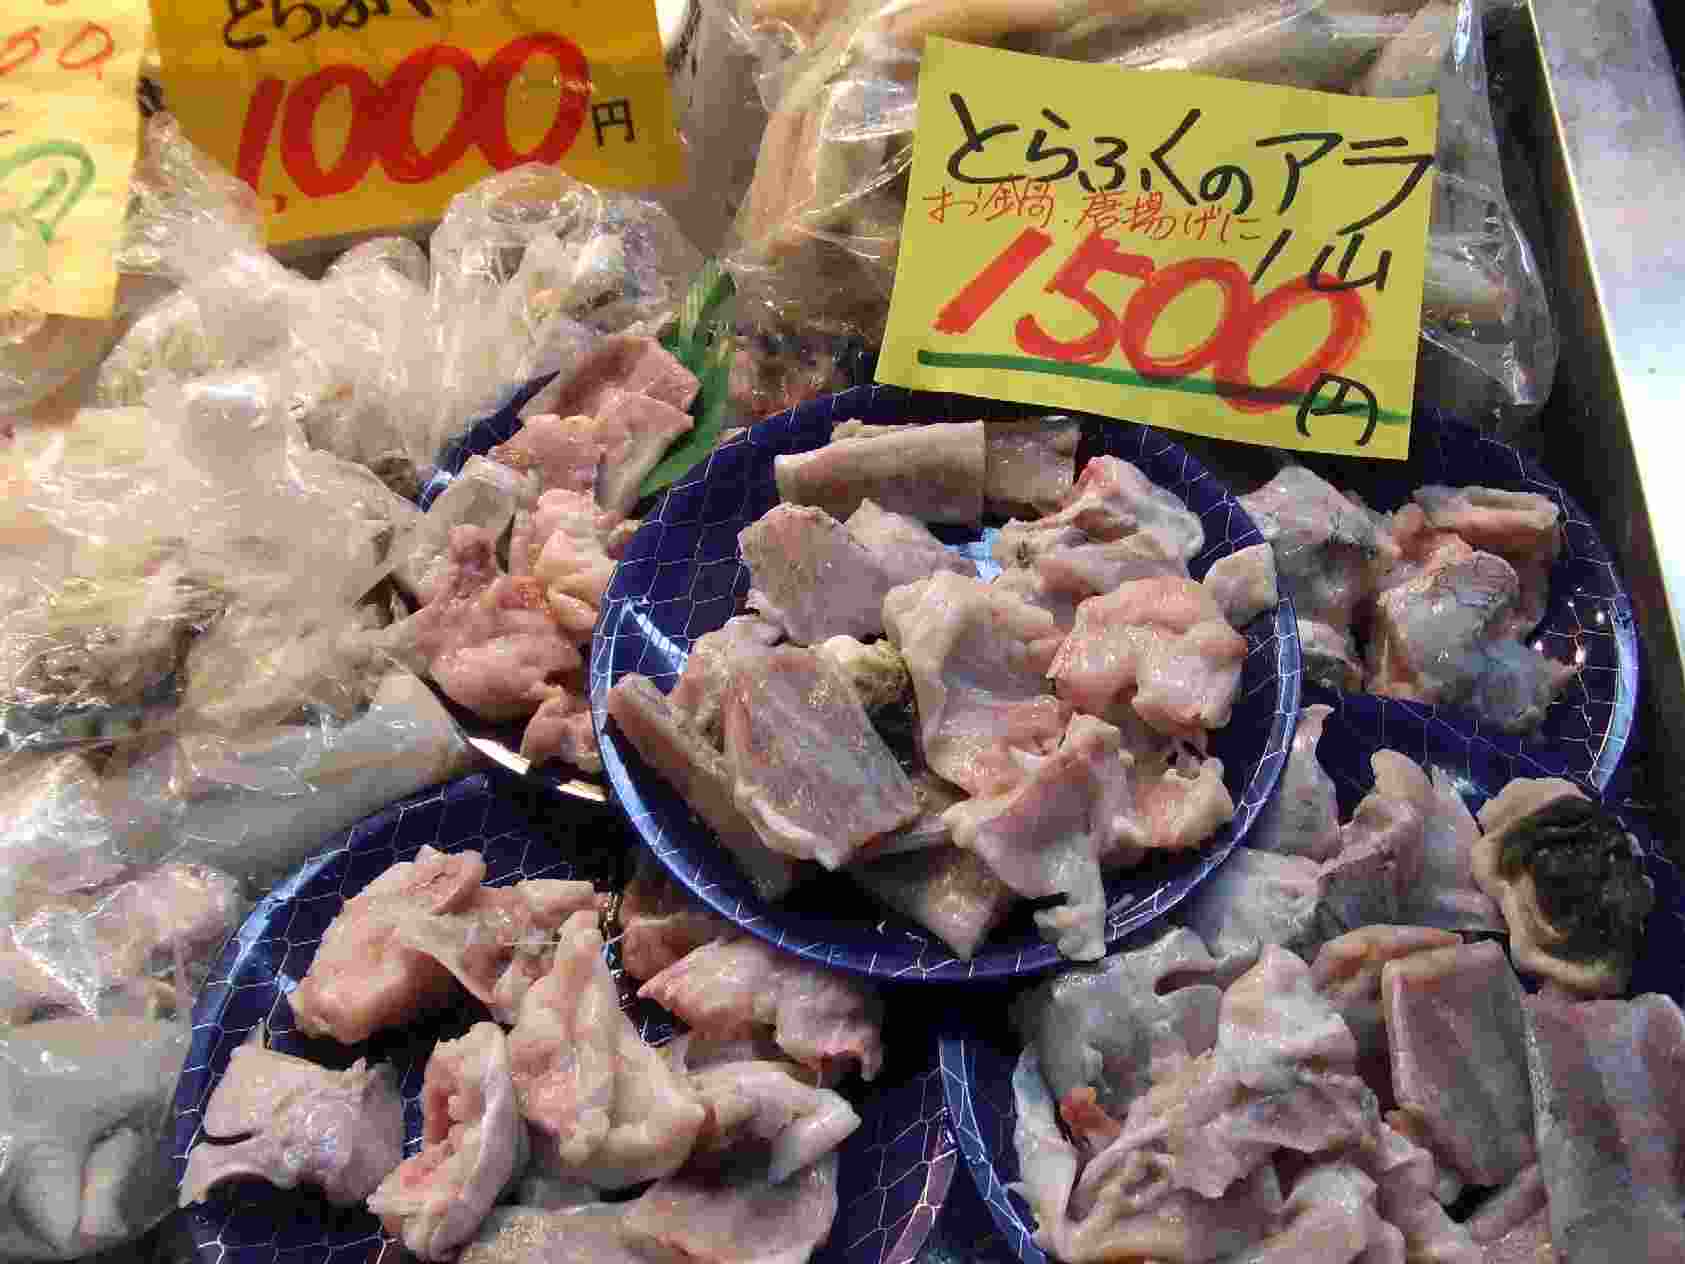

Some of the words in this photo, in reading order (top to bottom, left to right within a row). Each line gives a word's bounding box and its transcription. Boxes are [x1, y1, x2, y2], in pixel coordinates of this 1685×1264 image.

[947, 92, 1436, 236] とらふくのアラ
